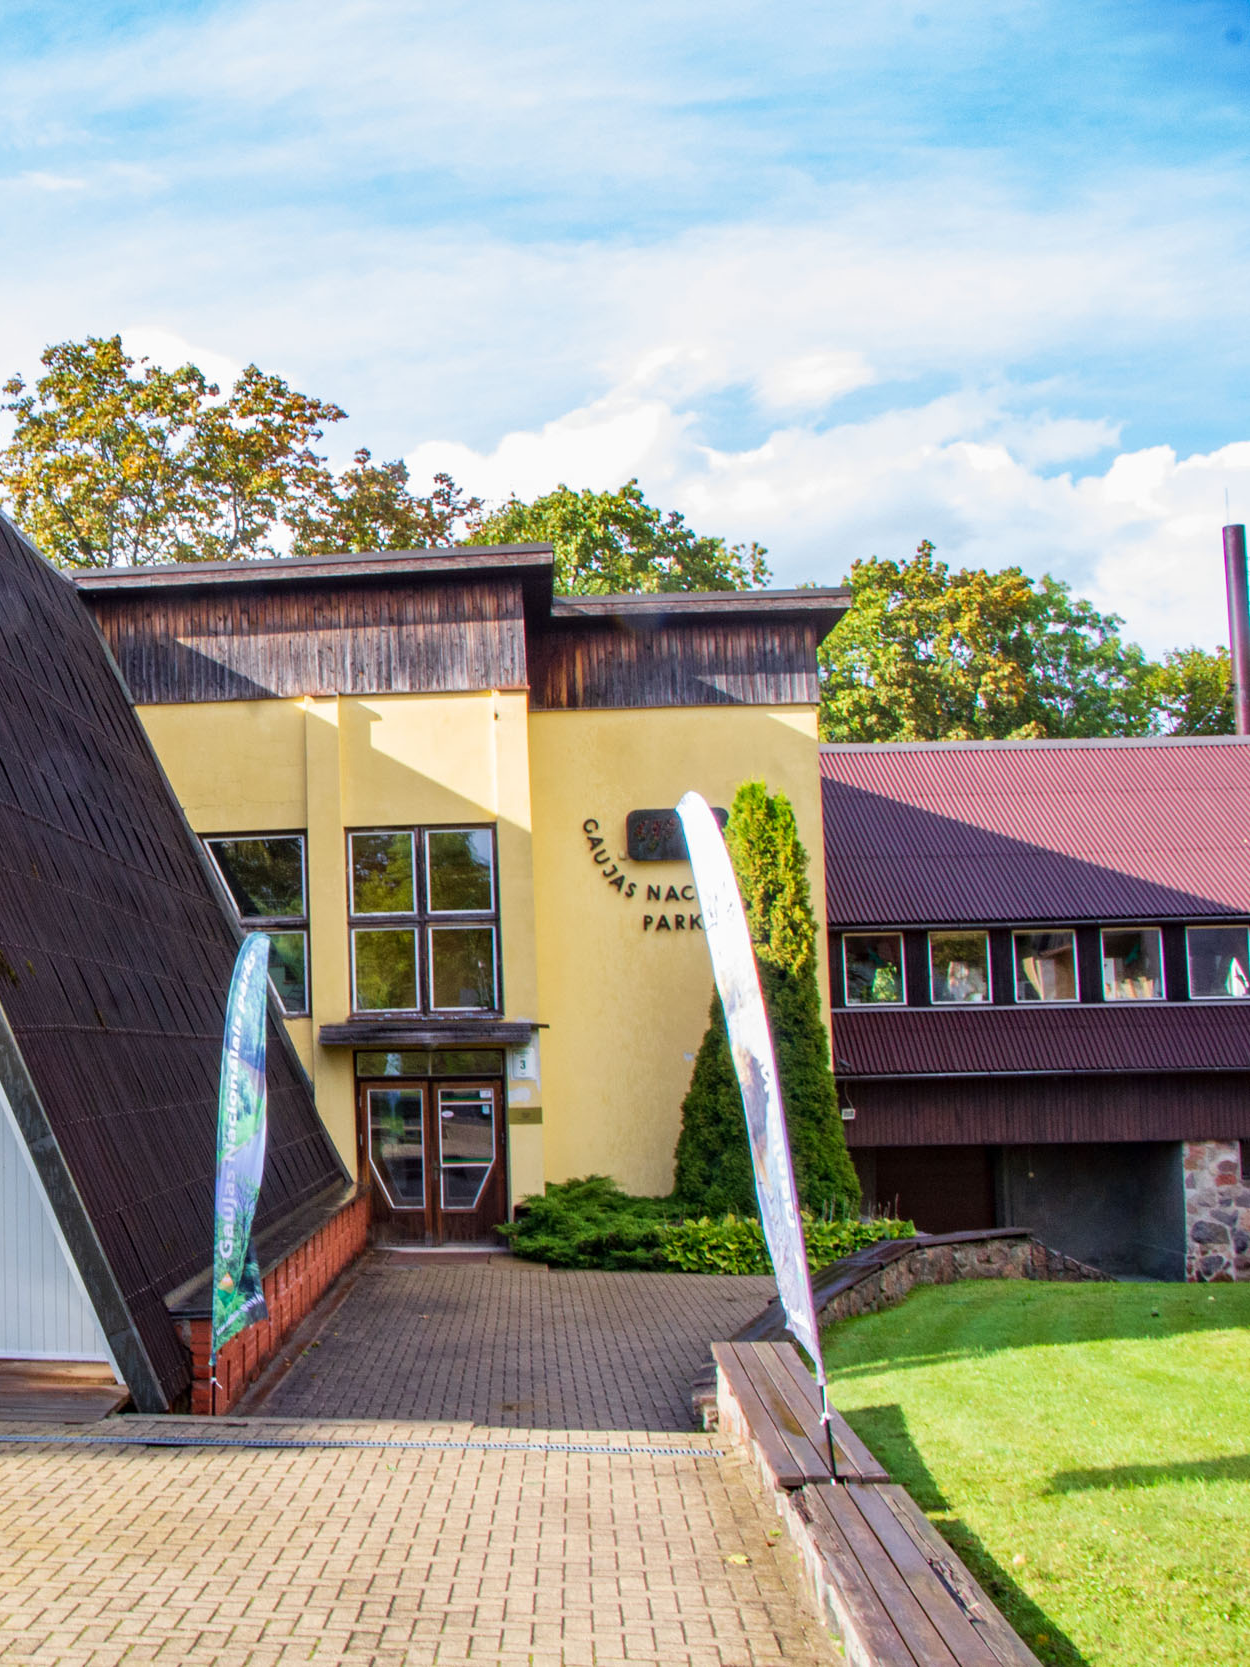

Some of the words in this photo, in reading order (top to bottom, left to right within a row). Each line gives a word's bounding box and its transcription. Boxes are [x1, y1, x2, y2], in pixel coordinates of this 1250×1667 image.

[583, 818, 637, 898] GAUJAS
[646, 884, 695, 901] NAC
[643, 914, 703, 931] PARK
[519, 1060, 526, 1070] 3
[219, 1168, 238, 1259] Gaujas
[237, 950, 256, 1014] parks
